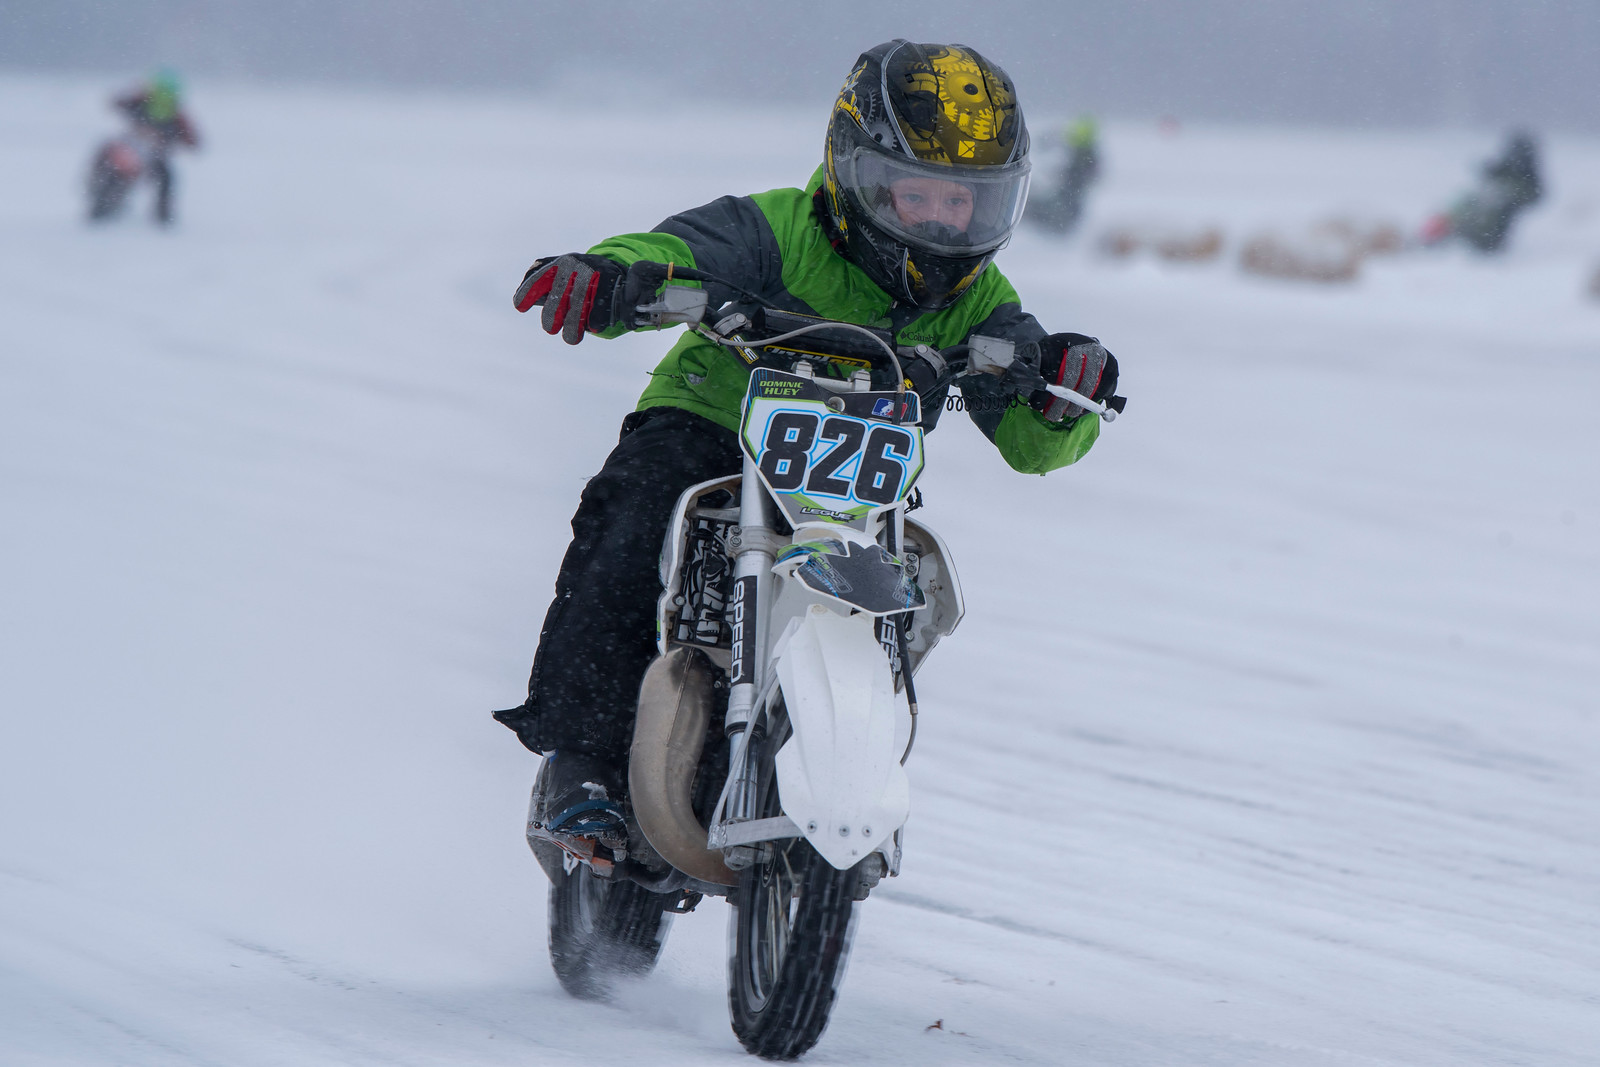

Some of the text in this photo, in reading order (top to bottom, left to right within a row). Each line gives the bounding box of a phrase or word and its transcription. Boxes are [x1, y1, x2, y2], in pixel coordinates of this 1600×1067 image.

[760, 380, 804, 388] DOMINIC
[764, 387, 800, 395] HUEY
[758, 411, 912, 505] 826
[731, 580, 745, 684] SPEED
